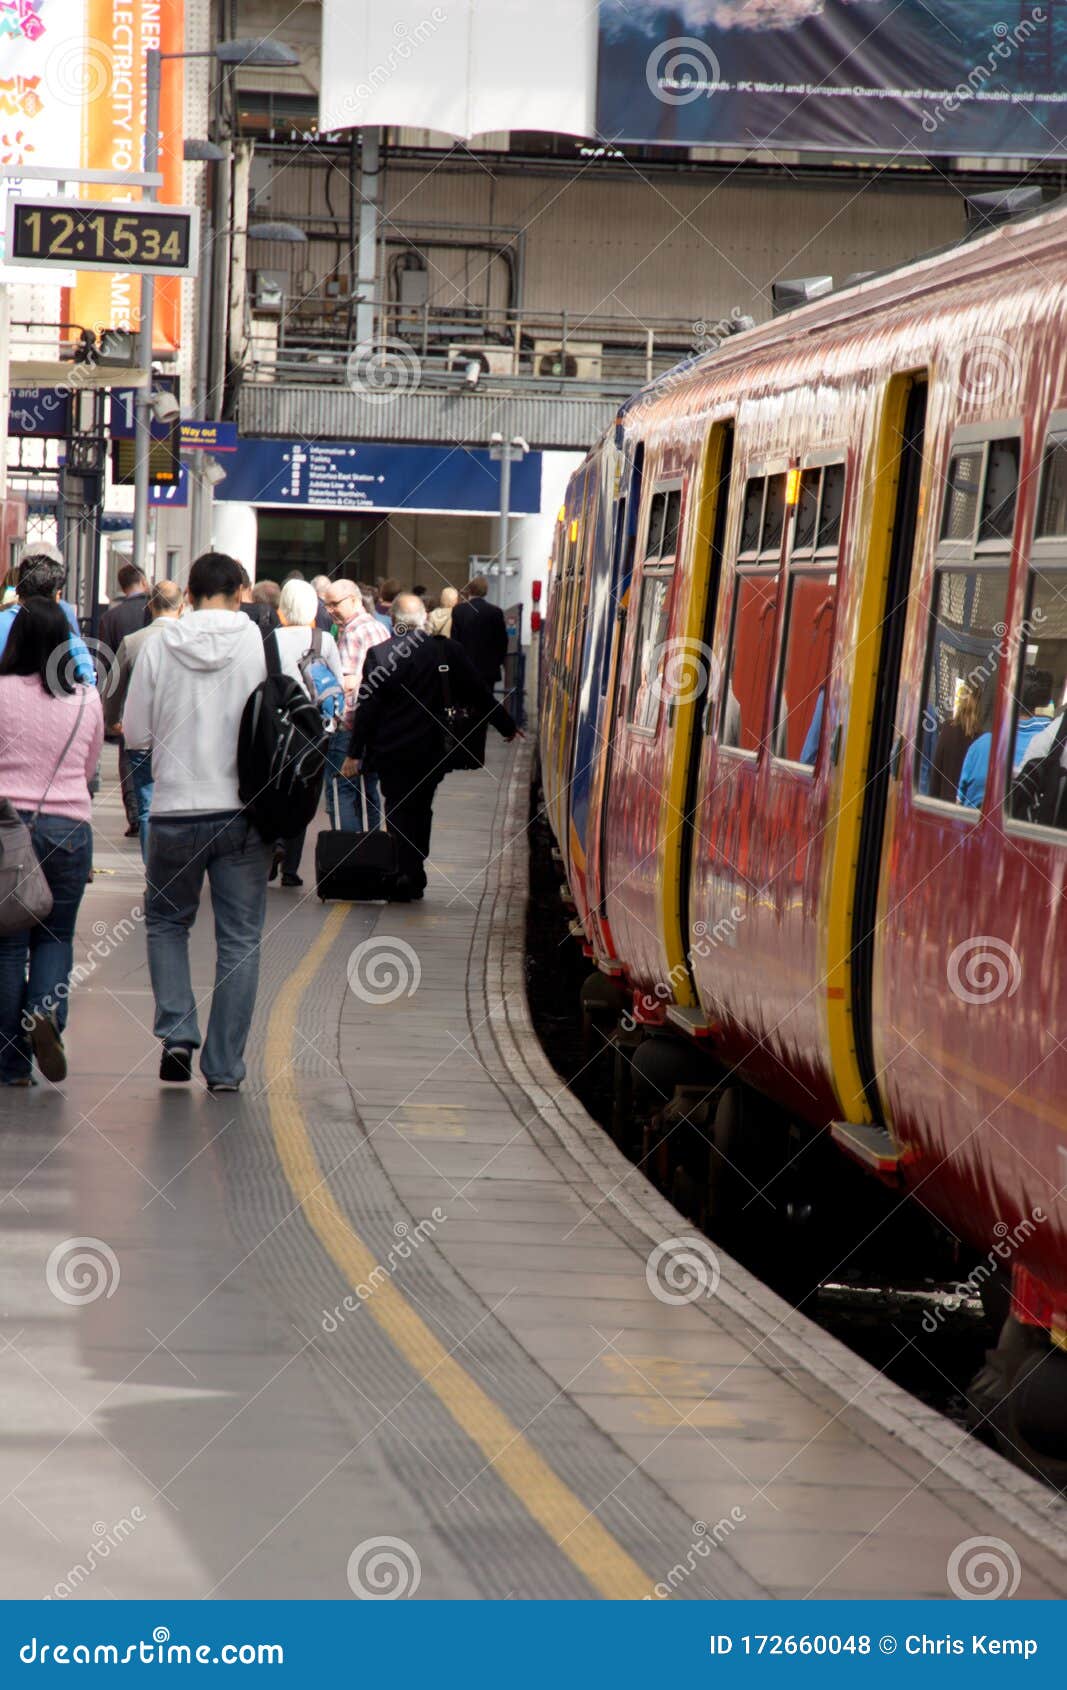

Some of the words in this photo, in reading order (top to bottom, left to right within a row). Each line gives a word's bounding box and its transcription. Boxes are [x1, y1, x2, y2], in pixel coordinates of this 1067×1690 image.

[754, 81, 784, 92] World
[785, 83, 805, 93] and
[806, 83, 852, 96] European
[853, 86, 901, 99] Champion
[903, 87, 922, 99] and
[181, 426, 200, 438] Way
